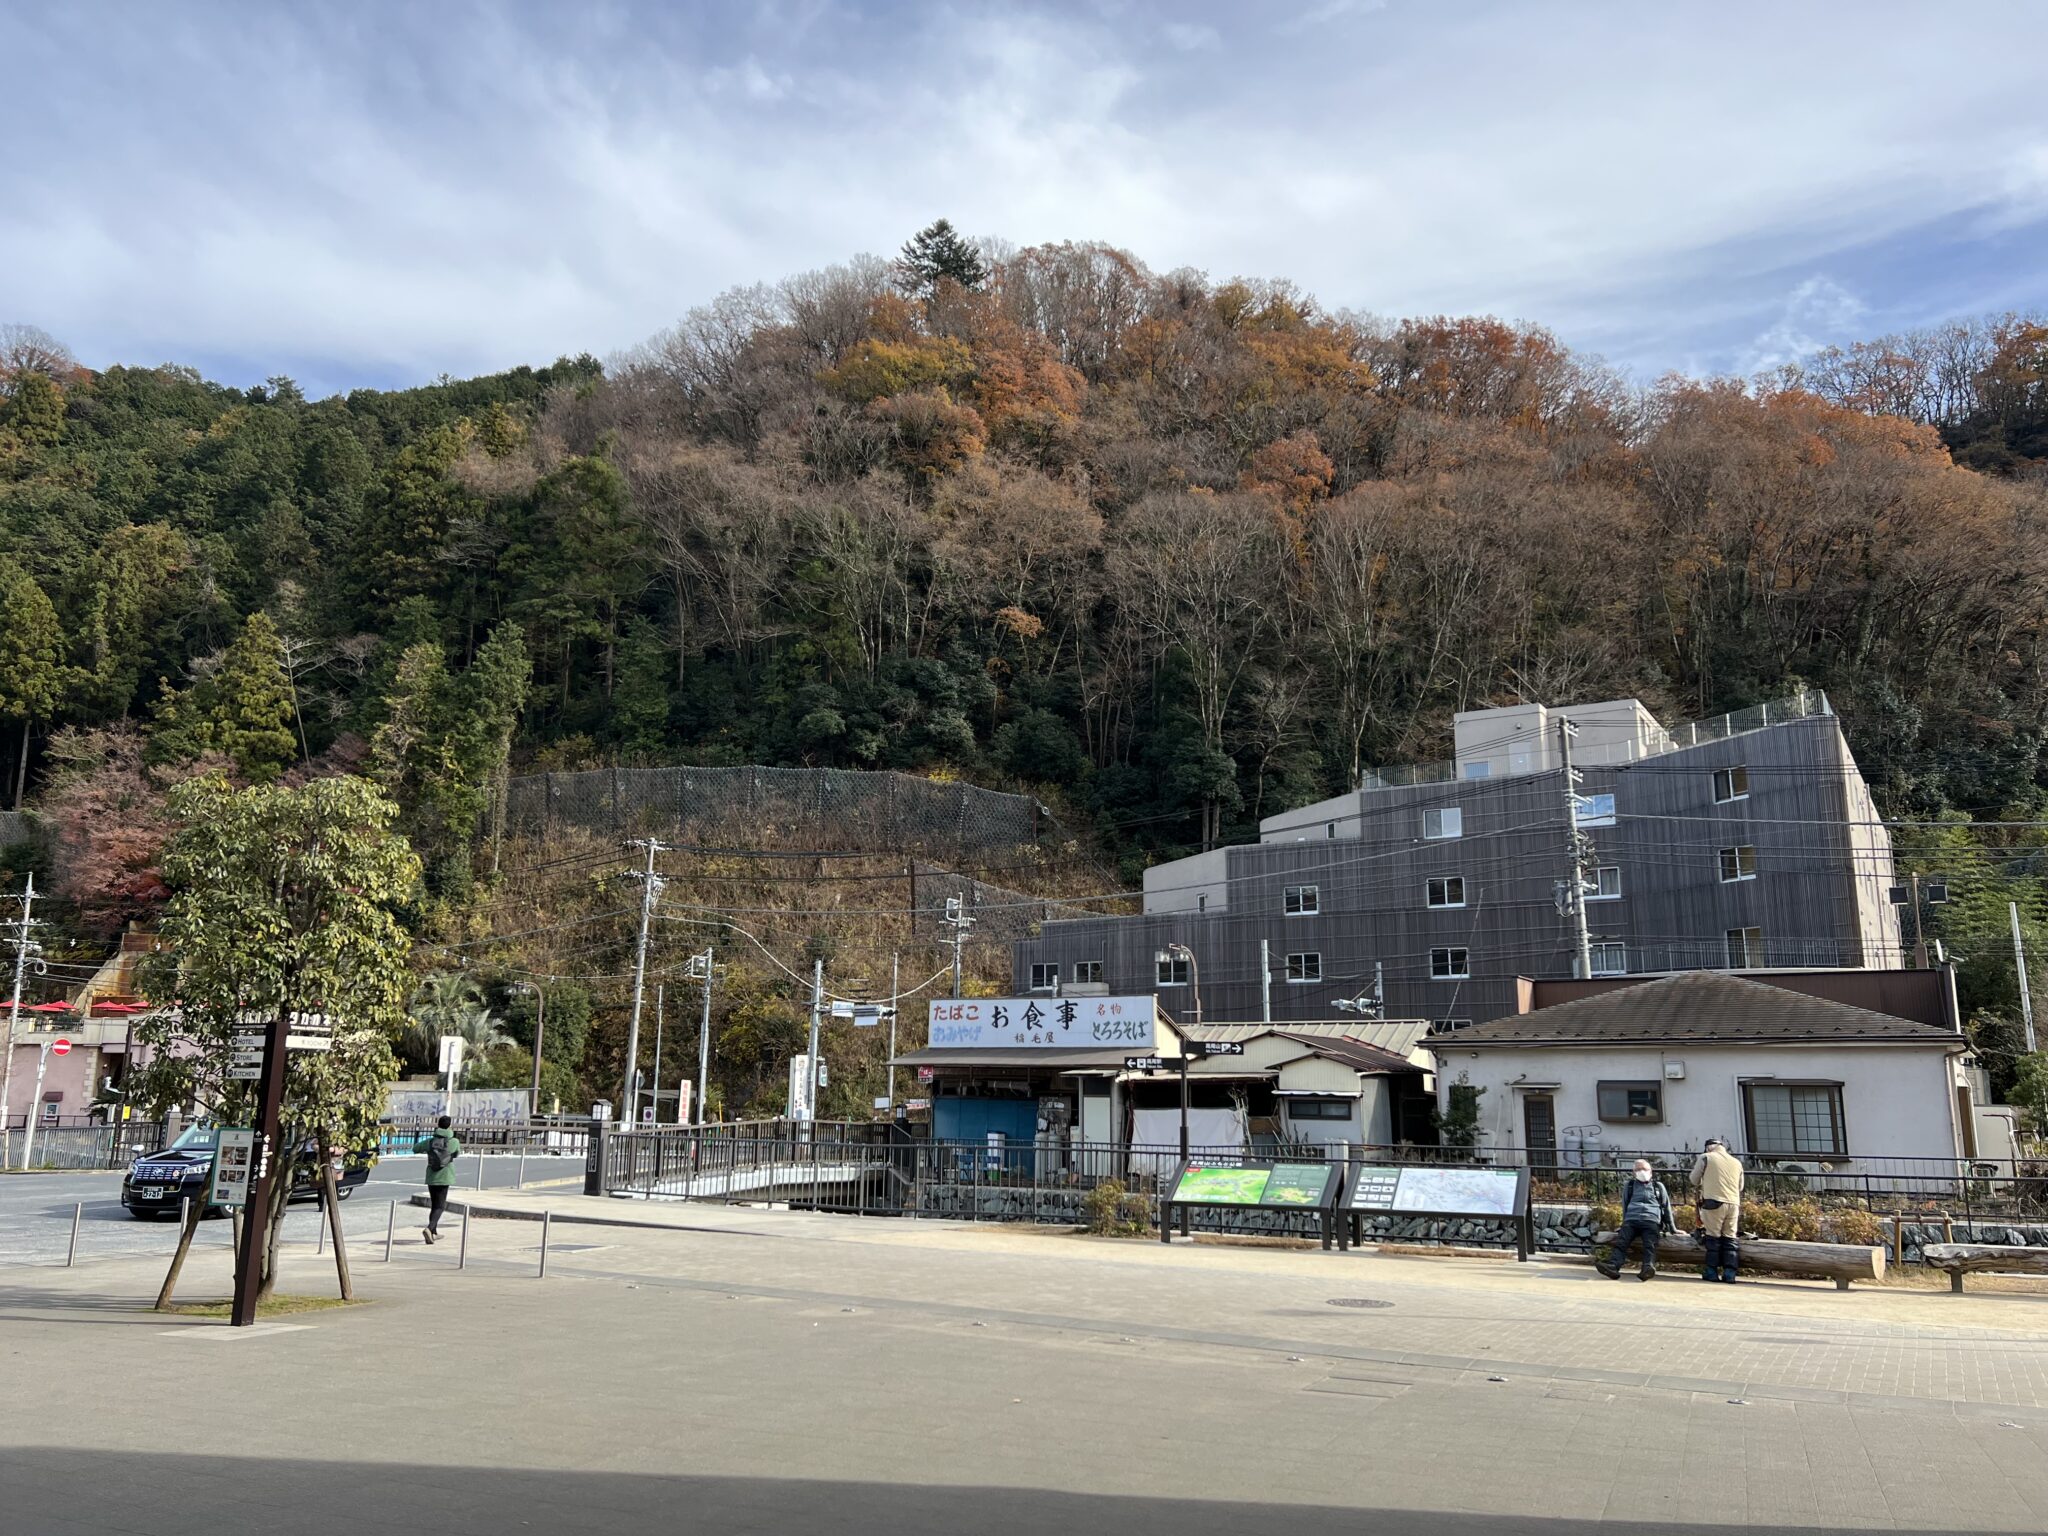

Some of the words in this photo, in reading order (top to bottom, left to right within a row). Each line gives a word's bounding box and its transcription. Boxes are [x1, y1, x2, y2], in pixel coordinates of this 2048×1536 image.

[933, 1005, 979, 1021] たばこ
[991, 1000, 1079, 1031] お食事
[1096, 1003, 1122, 1016] 名物
[932, 1025, 982, 1043] おみやげ
[1014, 1032, 1055, 1044] 稲毛屋
[1092, 1020, 1149, 1041] とろろそば
